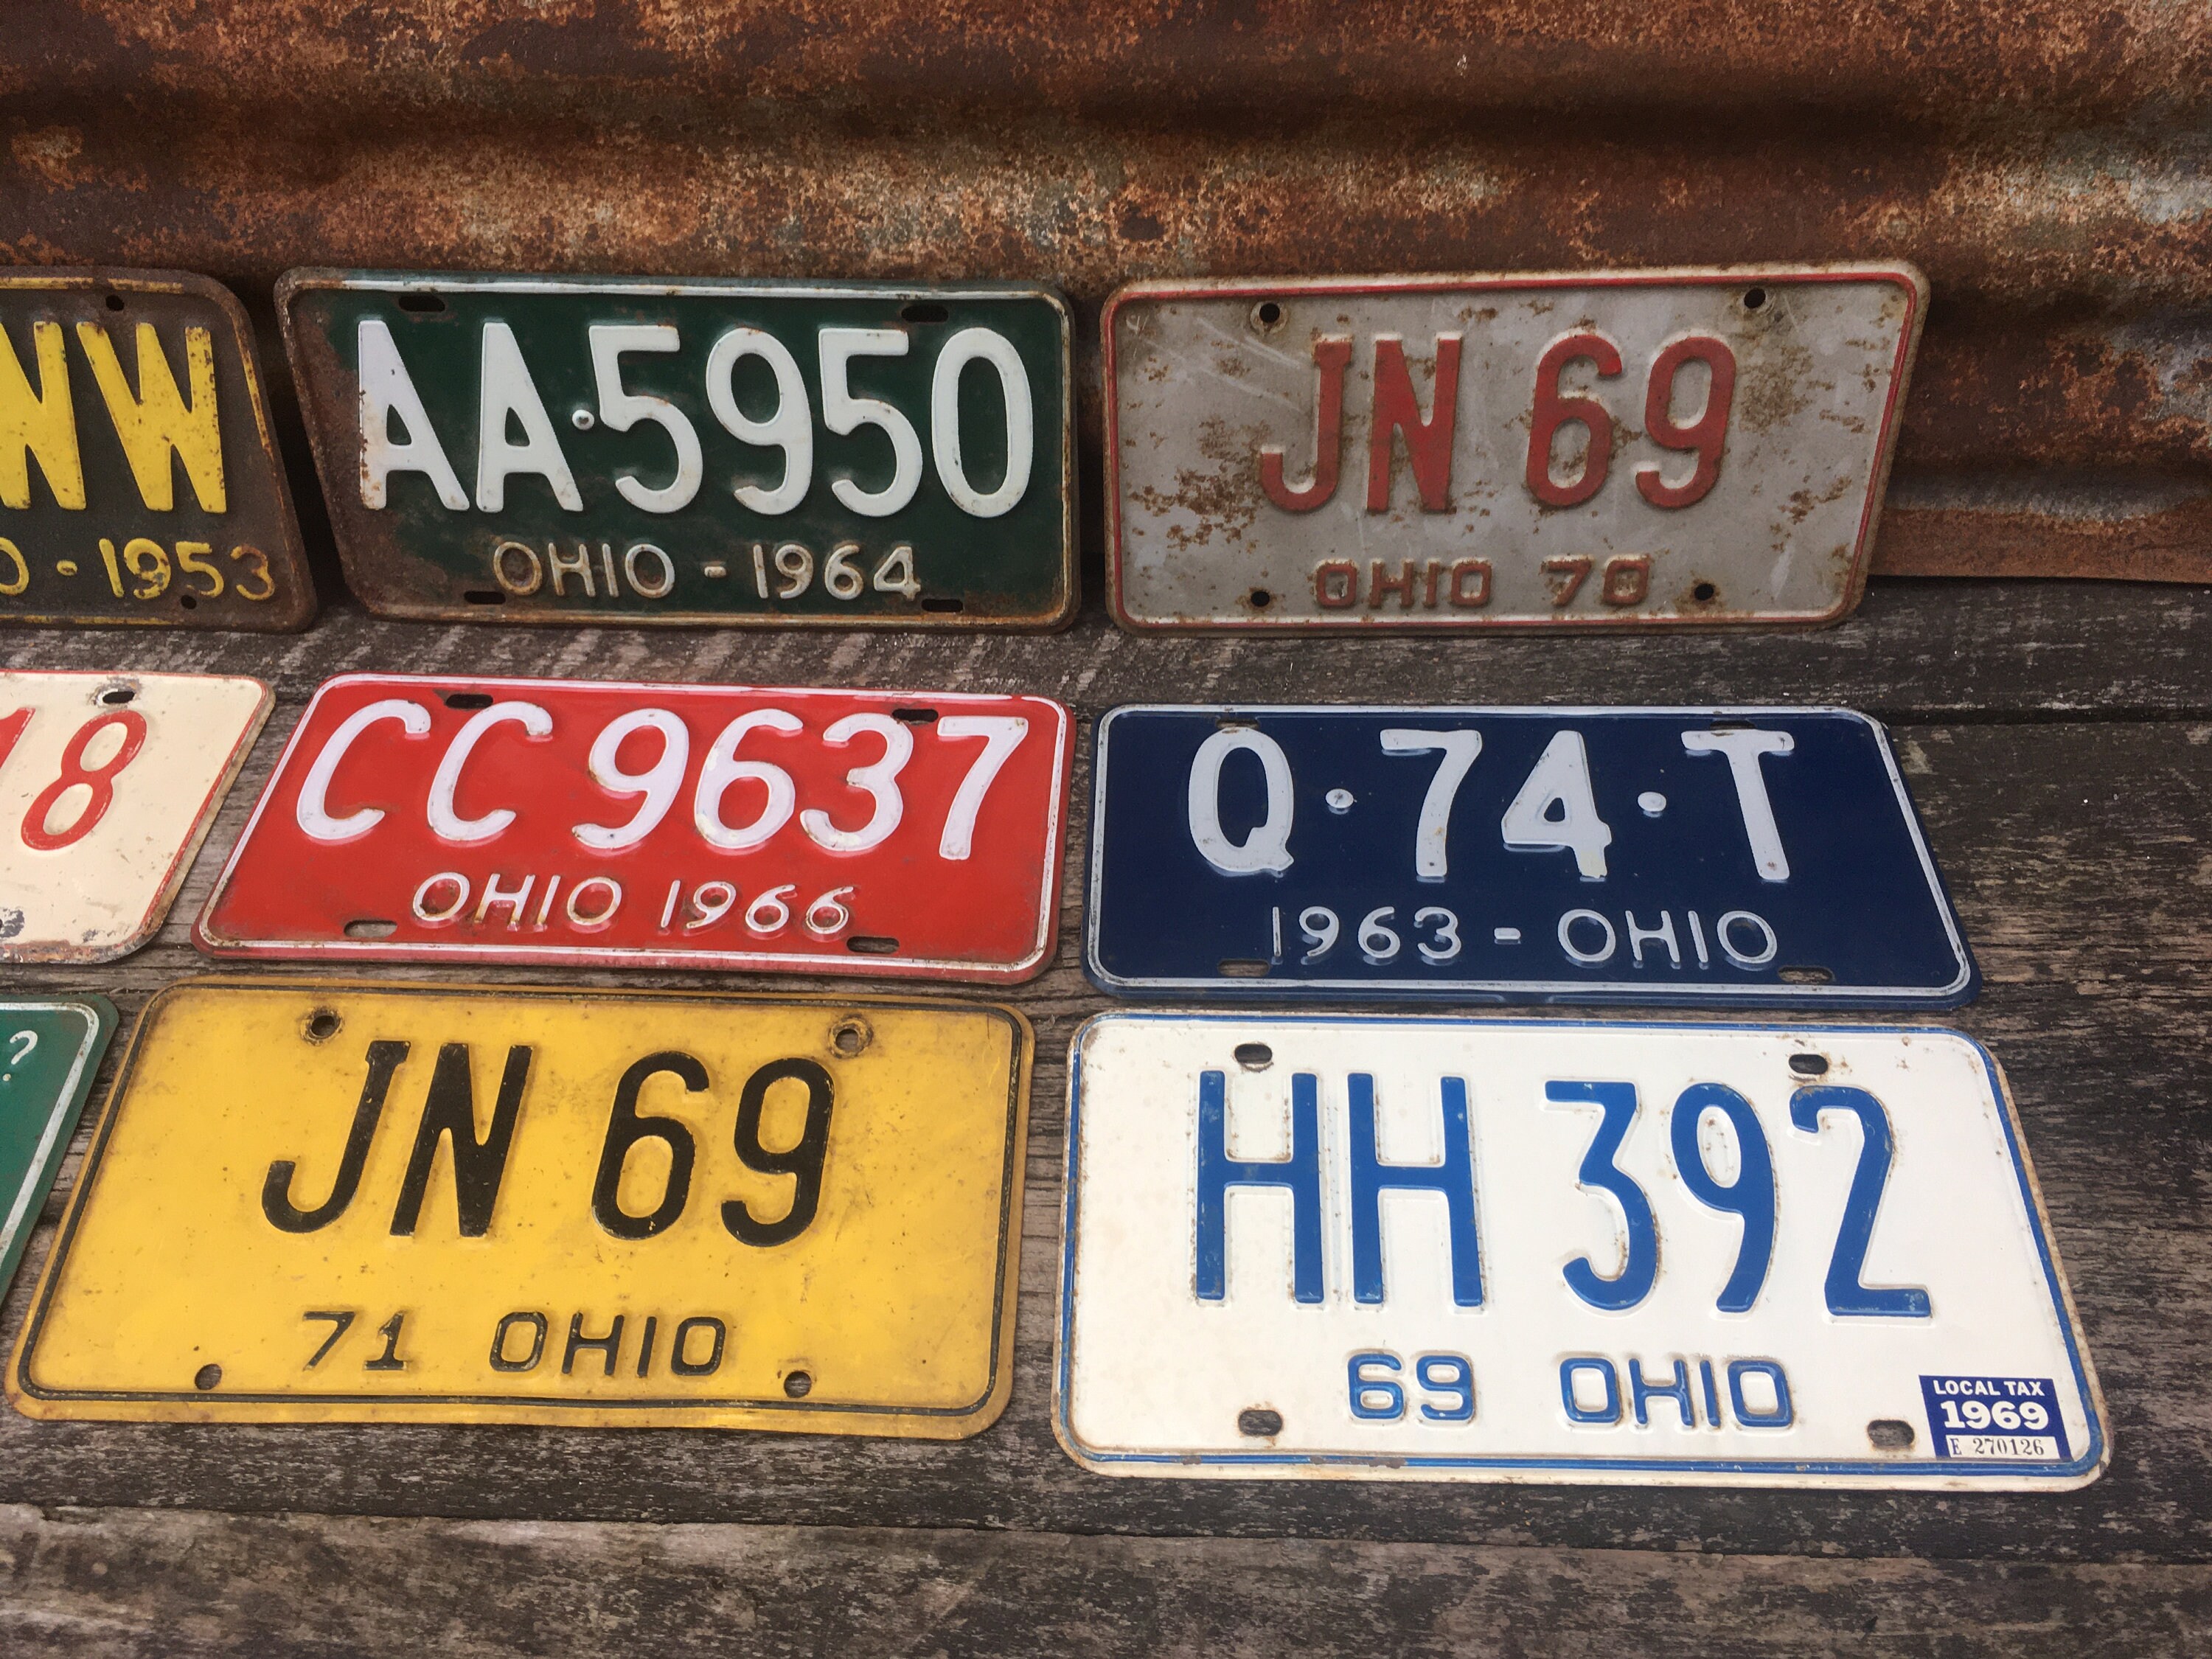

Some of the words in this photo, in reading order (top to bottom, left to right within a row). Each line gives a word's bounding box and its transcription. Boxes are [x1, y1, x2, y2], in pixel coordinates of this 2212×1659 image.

[1260, 332, 1462, 515] JN
[1525, 330, 1736, 509] 69
[99, 538, 275, 600] 1953
[493, 541, 675, 599] OHIO
[752, 544, 921, 601] 1964
[1315, 558, 1493, 608] OHIO
[1545, 554, 1652, 607] 70
[412, 872, 622, 929] OHIO
[660, 880, 855, 935] 1966
[1272, 905, 1463, 961] 1963
[1558, 908, 1778, 964] OHIO
[262, 1040, 533, 1238] JN
[591, 1050, 835, 1248] 69
[1195, 1070, 1484, 1307] HH
[1545, 1080, 1932, 1318] 392
[303, 1311, 409, 1371] 71
[489, 1312, 727, 1377] OHIO
[1347, 1353, 1475, 1421] 69
[1559, 1357, 1793, 1427] OHIO
[1933, 1380, 2000, 1396] LOCAL
[2003, 1381, 2045, 1397] TAX
[1940, 1400, 2049, 1430] 1969
[1949, 1438, 1963, 1455] E
[1973, 1438, 2045, 1456] 270126
